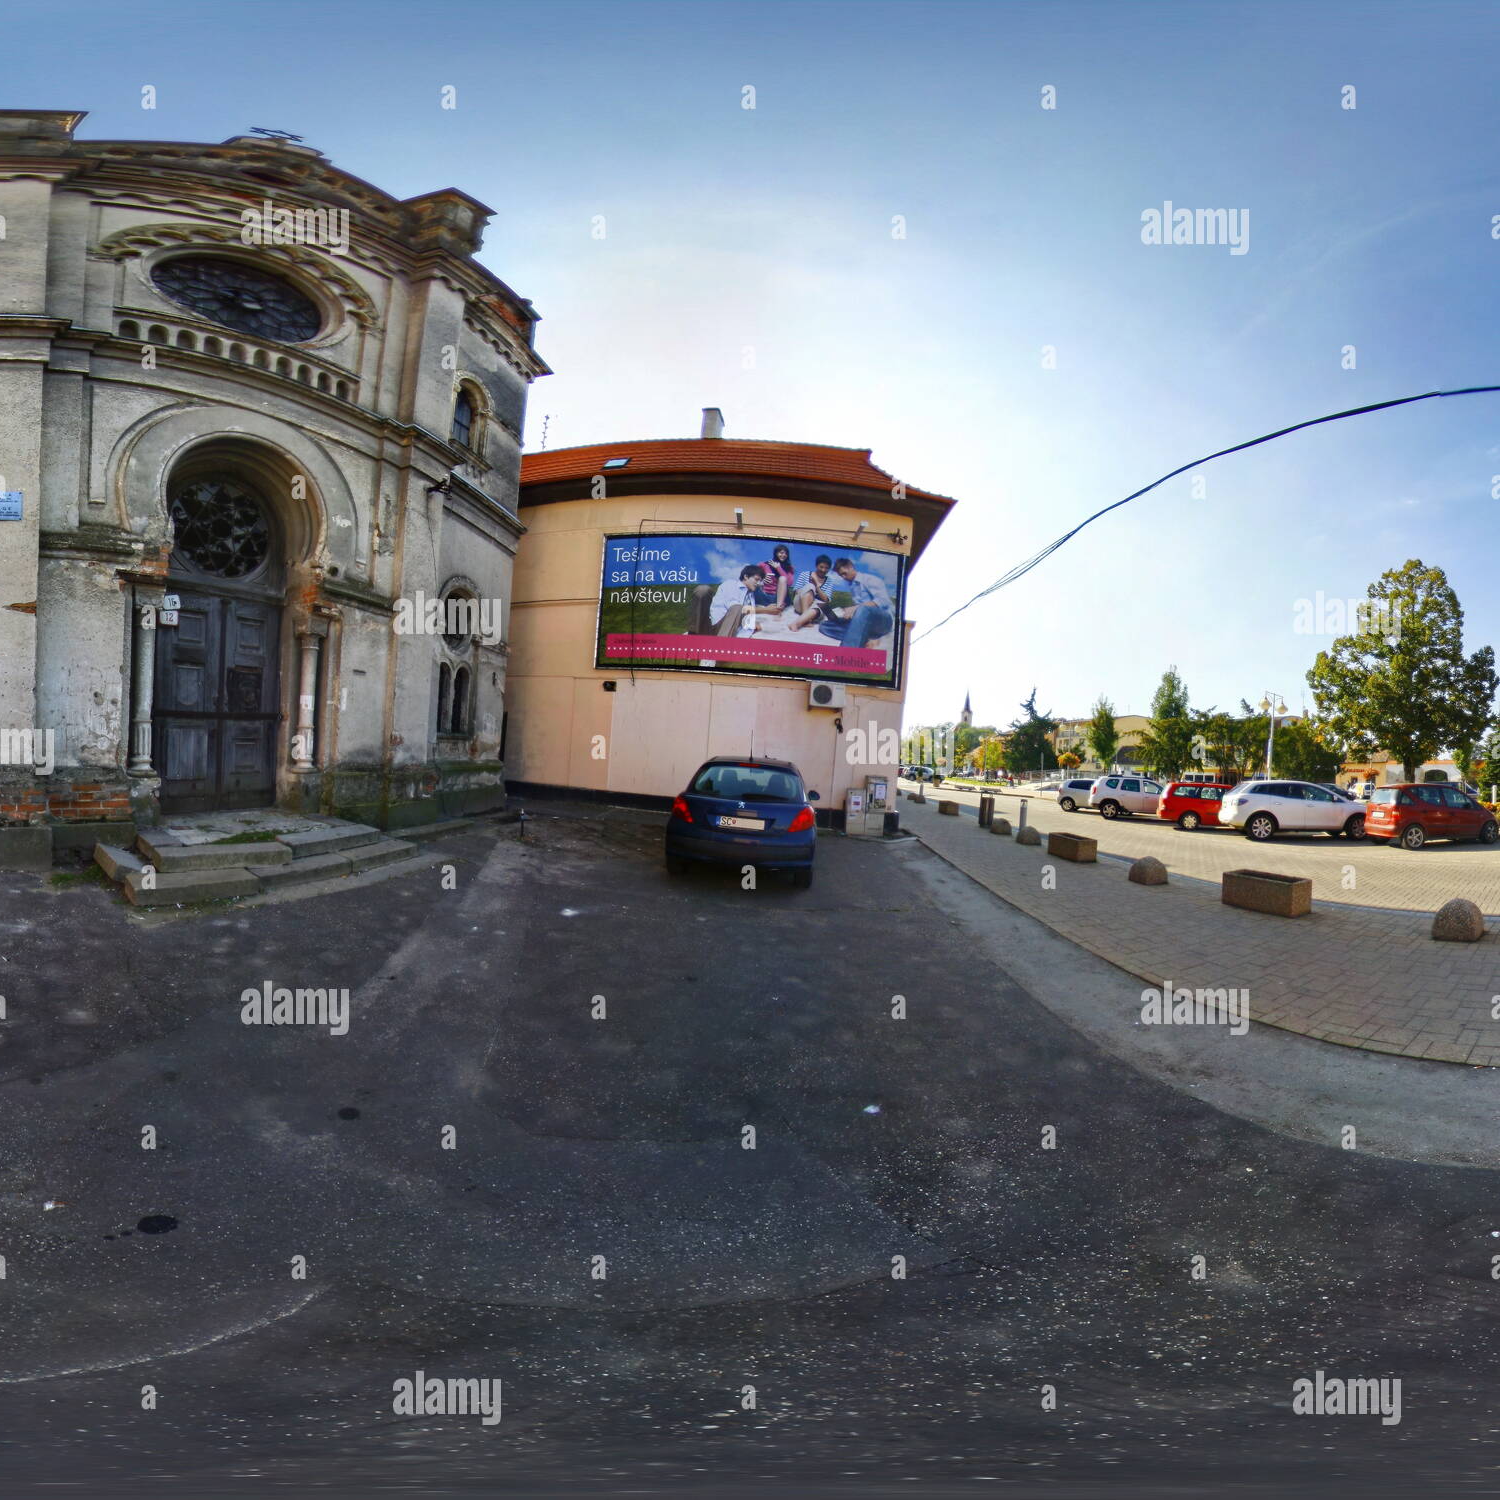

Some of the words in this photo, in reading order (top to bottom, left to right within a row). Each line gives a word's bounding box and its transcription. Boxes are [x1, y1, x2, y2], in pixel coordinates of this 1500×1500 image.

[612, 547, 670, 562] Tešíme
[611, 570, 629, 583] sa
[635, 570, 654, 582] na
[660, 566, 698, 582] vašu
[610, 587, 686, 603] návštevu!
[165, 612, 174, 622] 12
